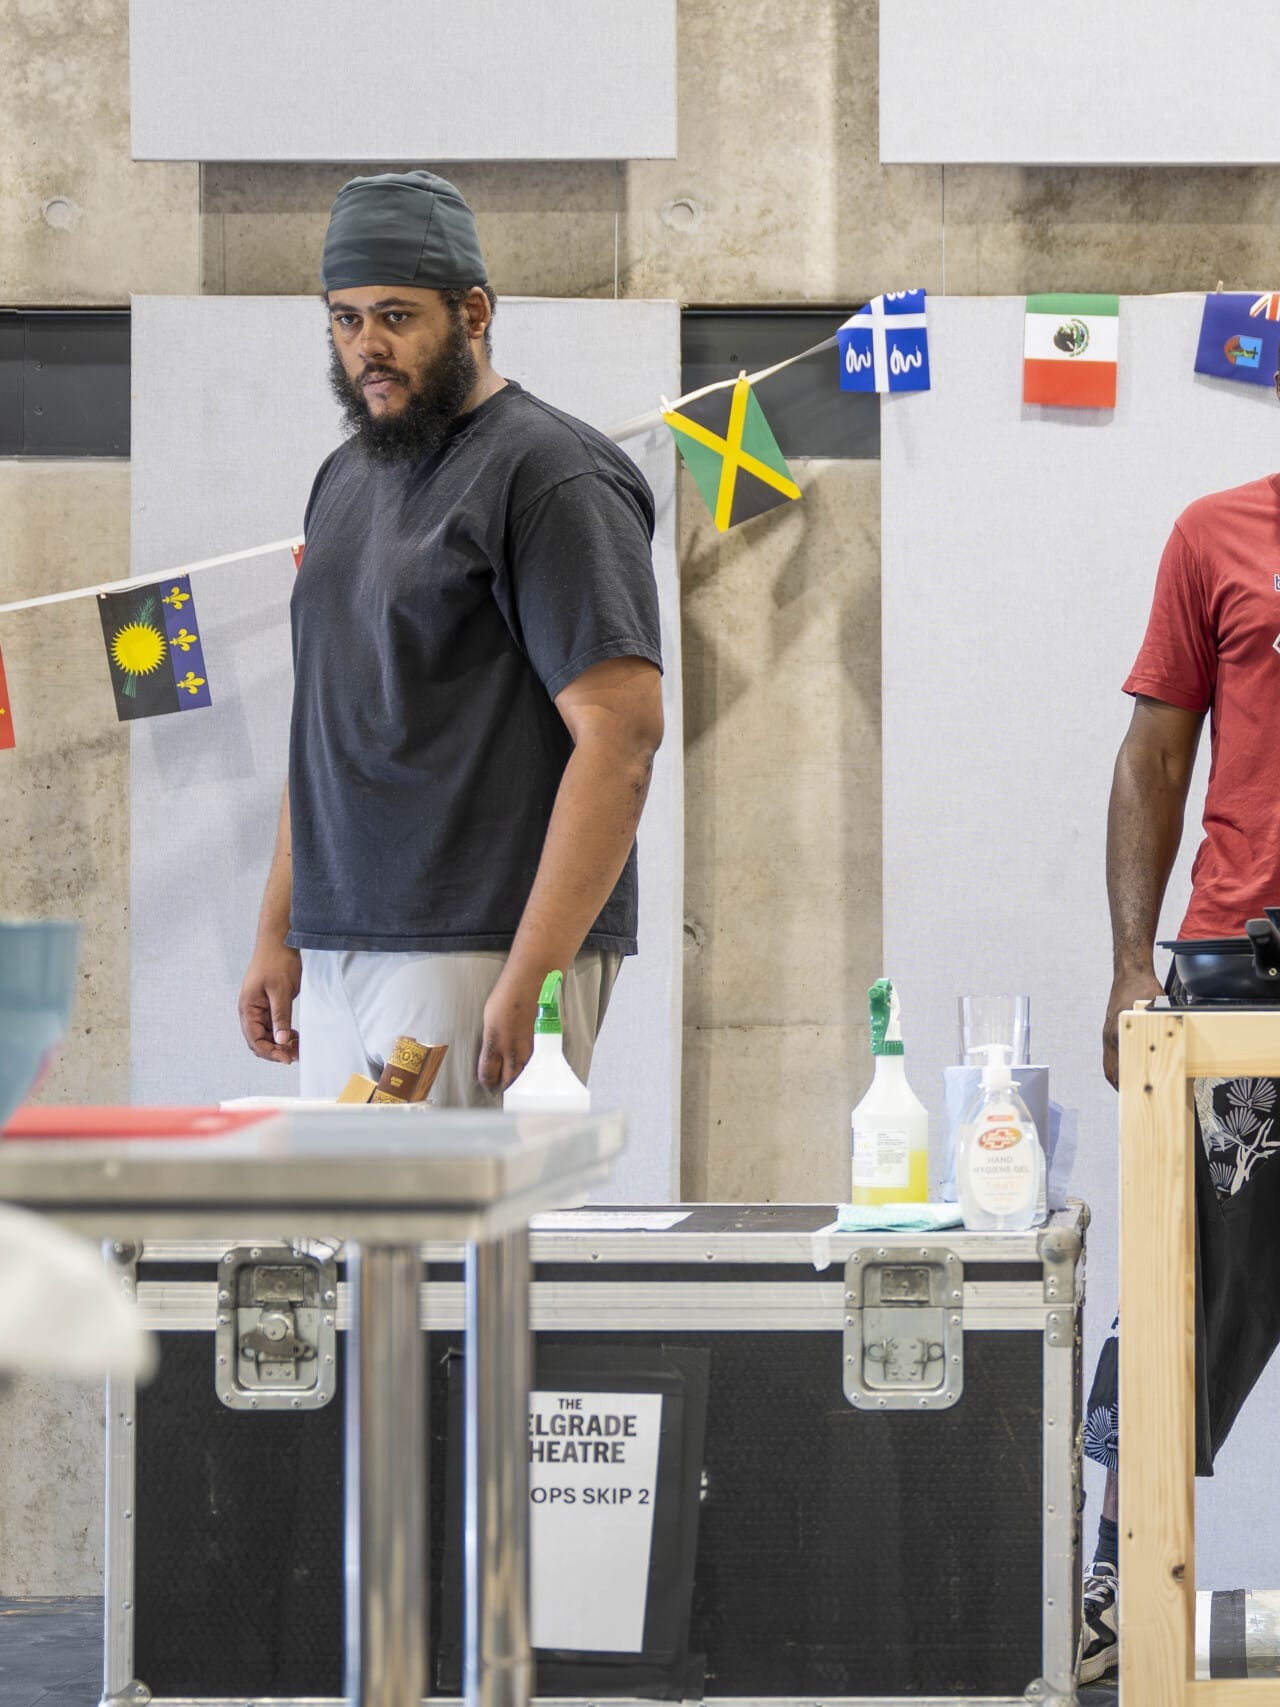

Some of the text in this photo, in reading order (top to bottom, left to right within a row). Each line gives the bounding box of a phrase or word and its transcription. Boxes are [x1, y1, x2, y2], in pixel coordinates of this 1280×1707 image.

[987, 1156, 1013, 1164] HAND
[558, 1398, 583, 1410] THE
[529, 1440, 625, 1463] HEATRE
[530, 1487, 650, 1505] OPS SKIP 2
